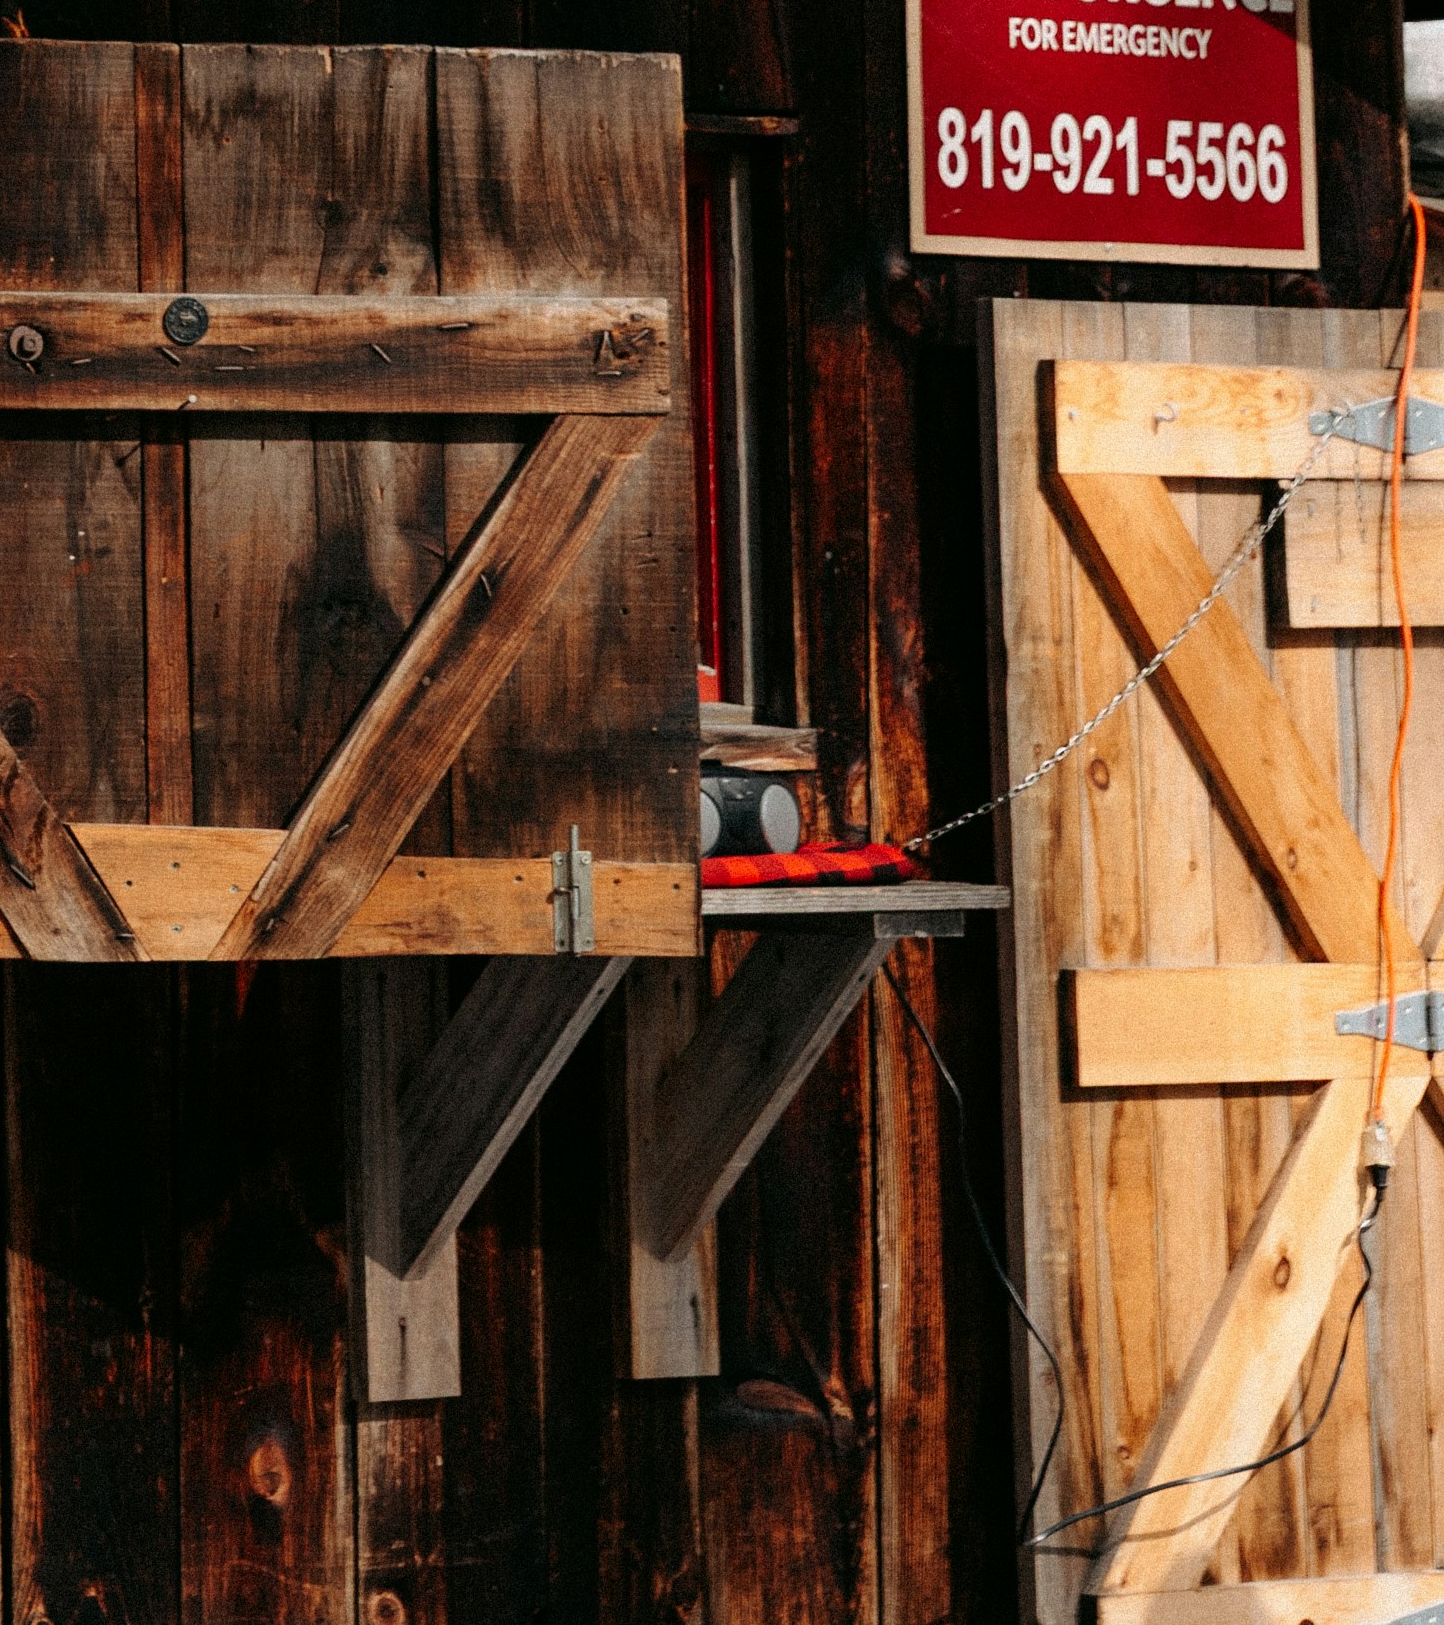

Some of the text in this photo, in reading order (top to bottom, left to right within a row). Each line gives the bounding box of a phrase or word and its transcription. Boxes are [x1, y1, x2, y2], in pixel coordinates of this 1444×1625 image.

[1008, 16, 1213, 60] FOR EMERGENCY
[937, 106, 1289, 204] 819-921-5566
